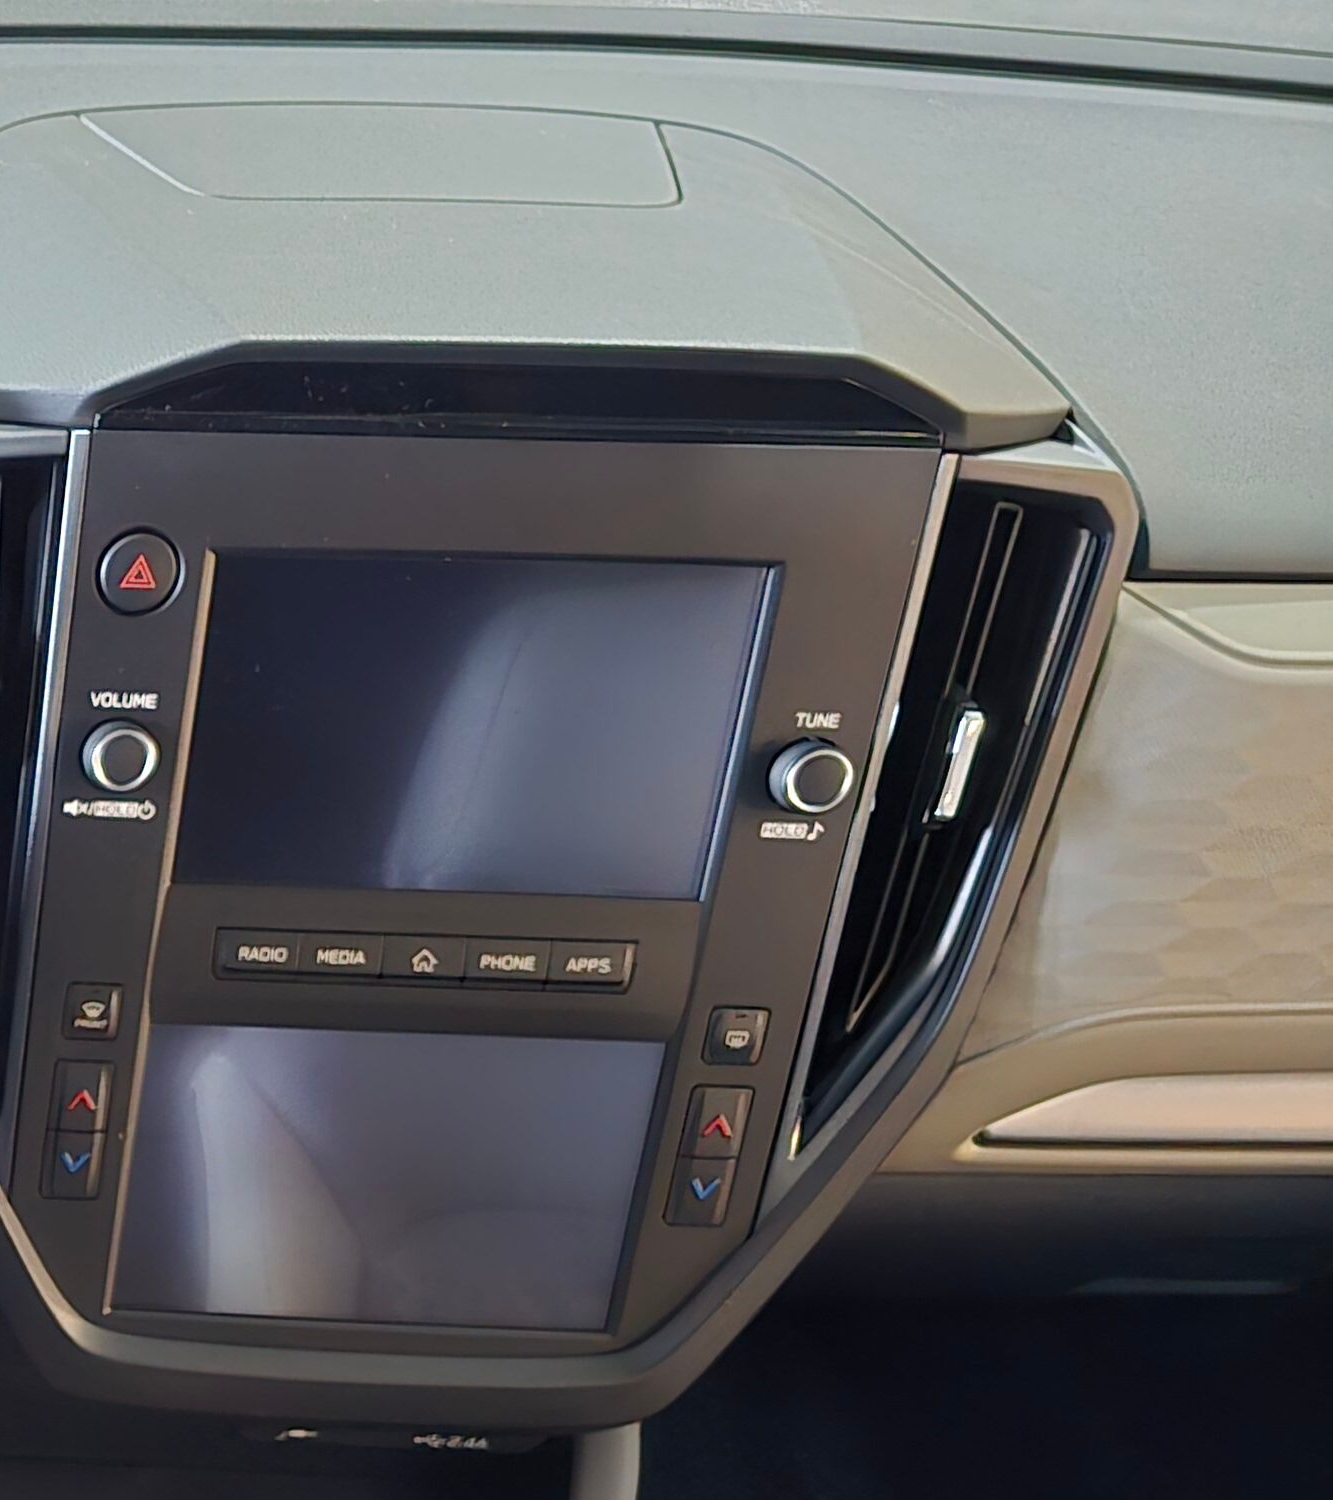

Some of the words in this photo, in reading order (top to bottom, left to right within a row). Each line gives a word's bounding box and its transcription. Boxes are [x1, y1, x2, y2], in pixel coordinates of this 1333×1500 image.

[90, 691, 158, 710] VOLUME
[795, 711, 842, 729] TUNE
[237, 945, 289, 963] RADIO
[316, 948, 366, 966] MEDIA
[479, 954, 537, 972] PHONE
[565, 957, 612, 974] APPS
